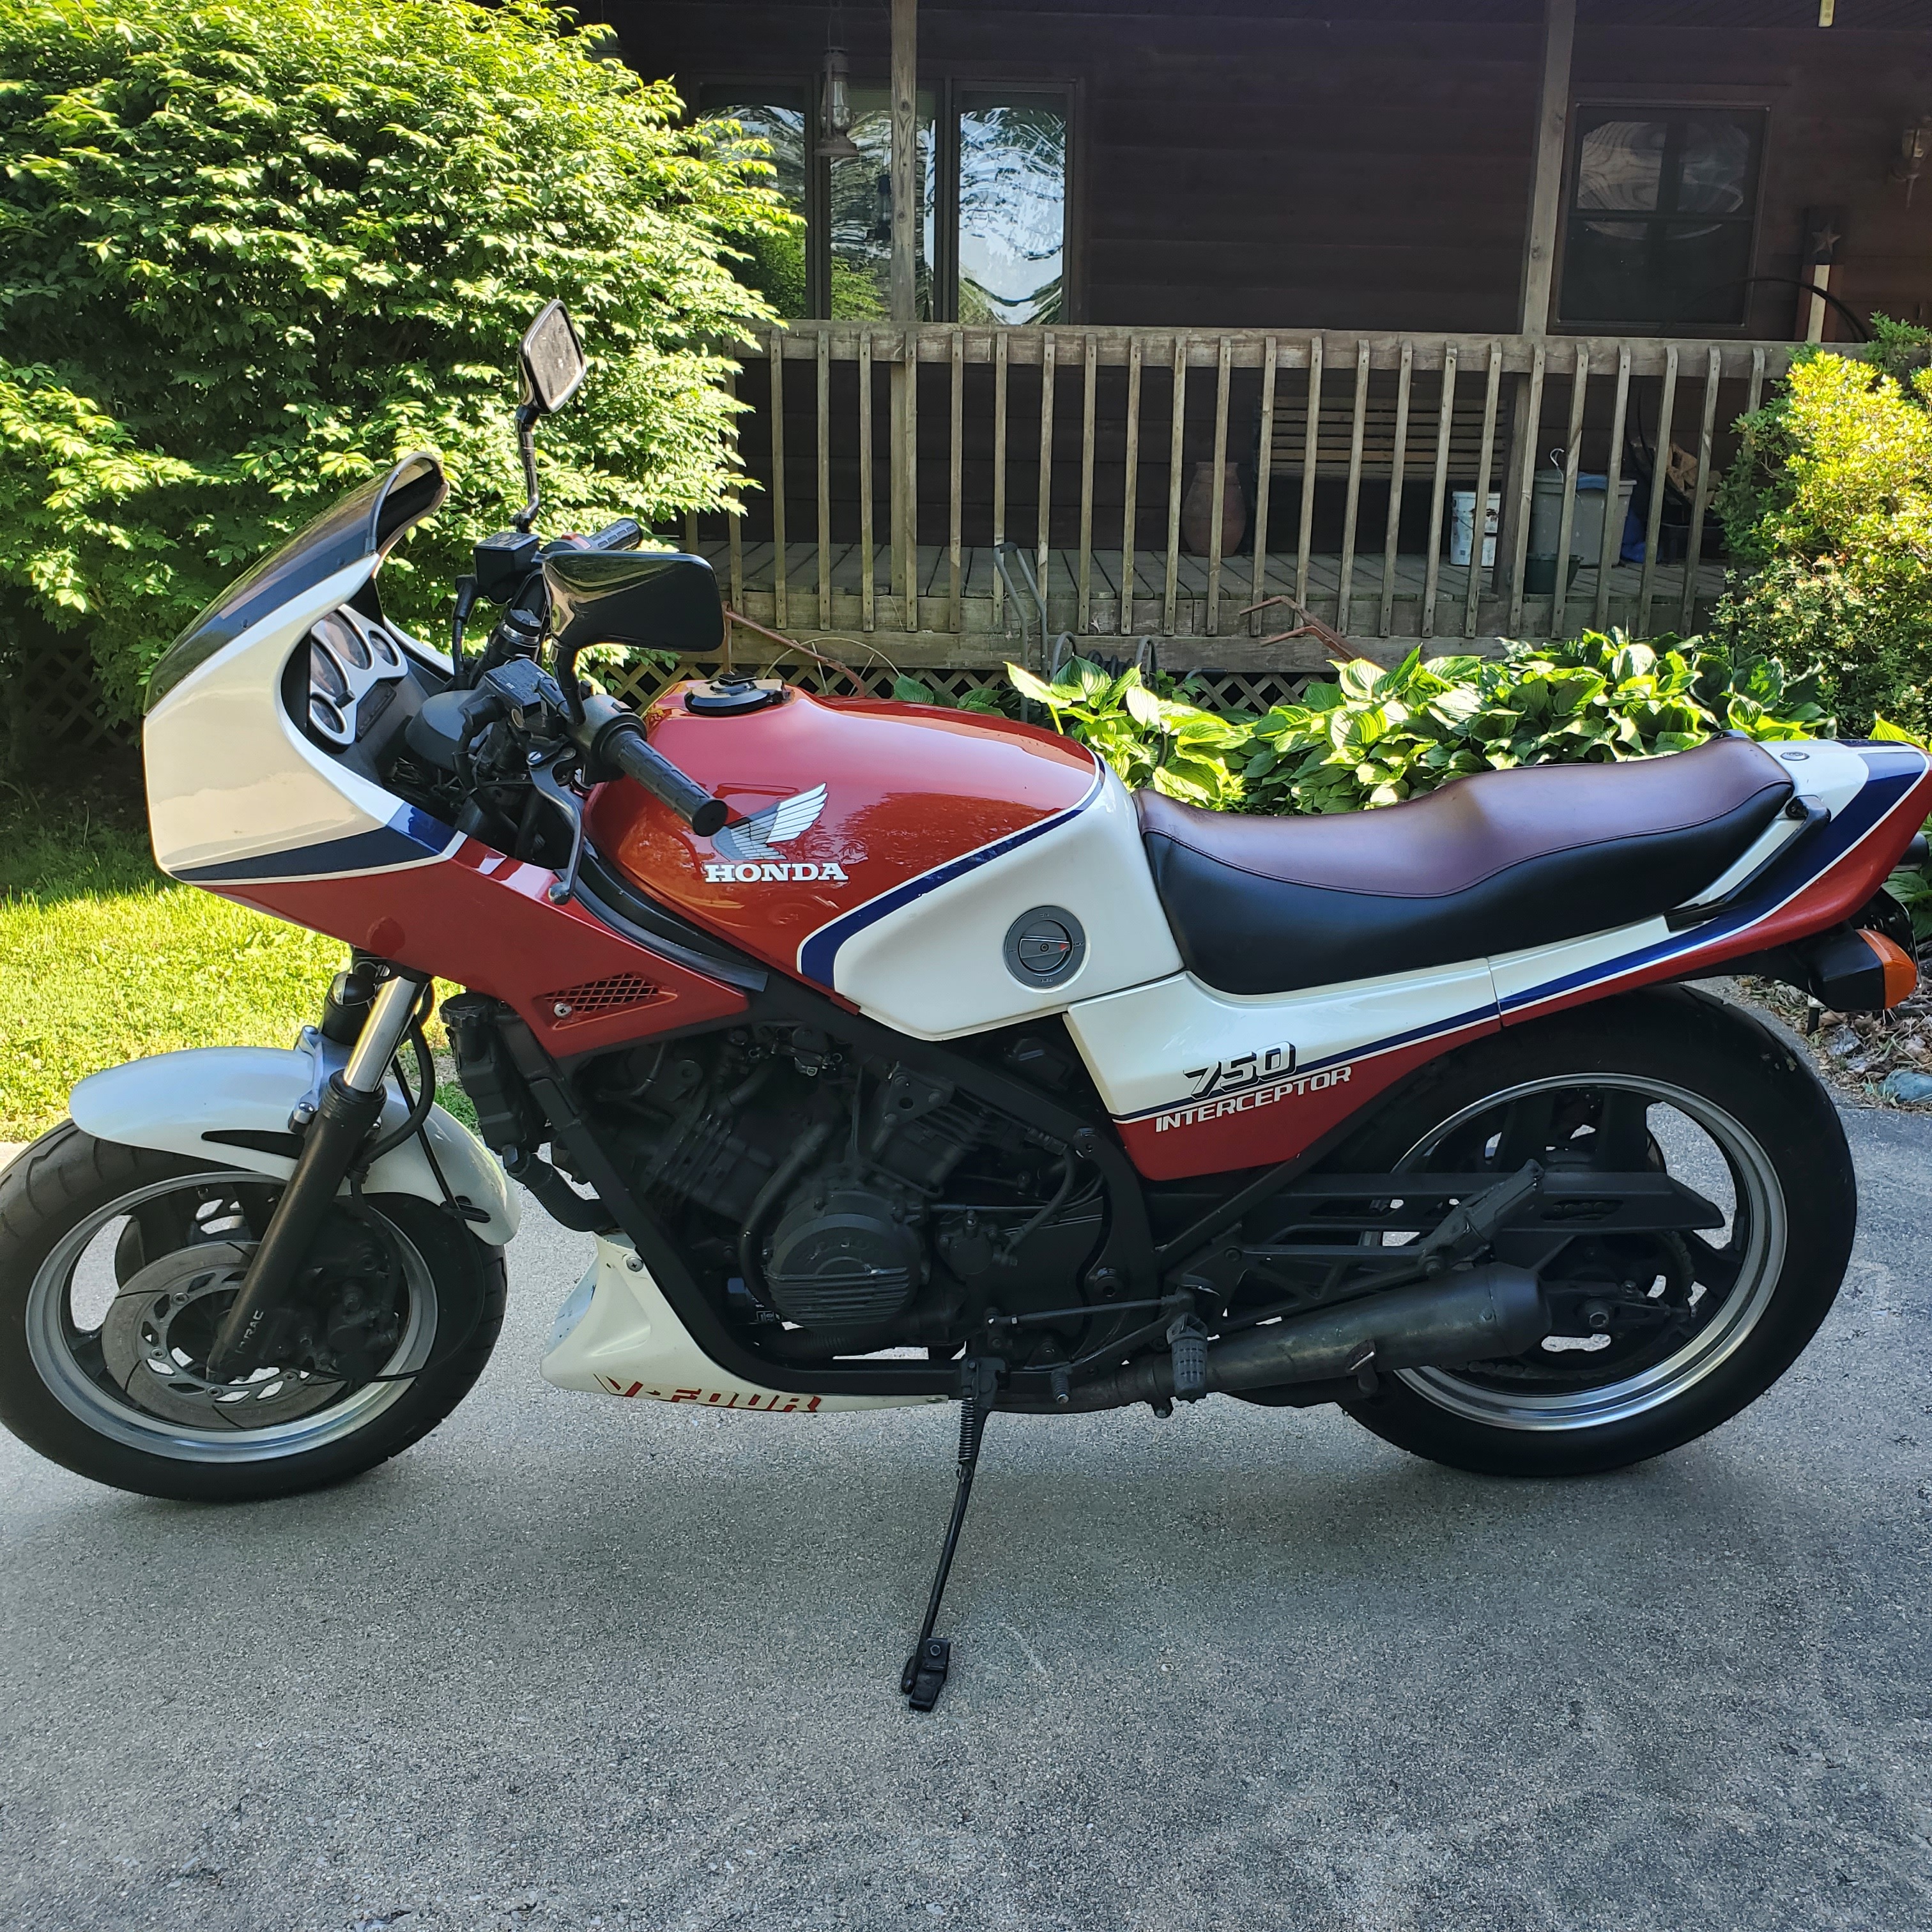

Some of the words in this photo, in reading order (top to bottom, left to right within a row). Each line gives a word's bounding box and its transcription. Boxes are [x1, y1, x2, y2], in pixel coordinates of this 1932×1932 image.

[705, 862, 849, 883] HONDA
[1183, 1040, 1297, 1100] 750
[1155, 1066, 1352, 1133] INTERCEPTOR
[593, 1373, 822, 1413] V-FOUR
